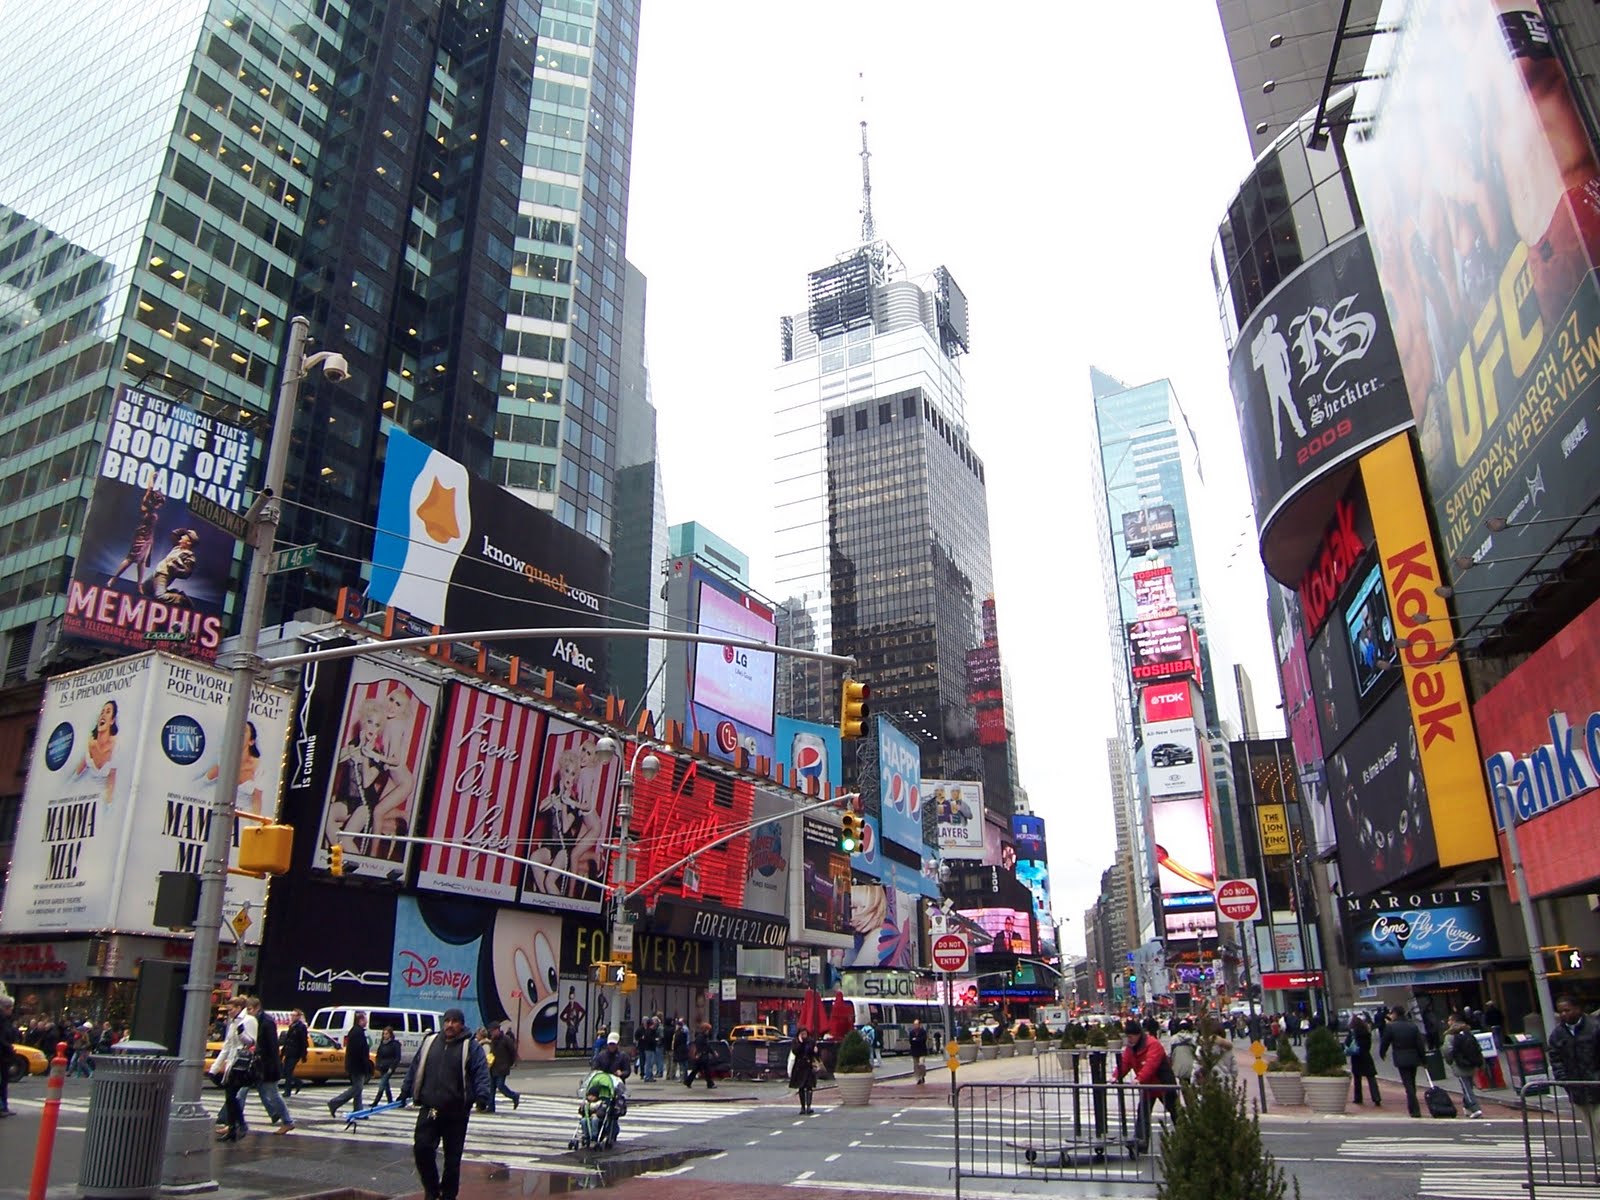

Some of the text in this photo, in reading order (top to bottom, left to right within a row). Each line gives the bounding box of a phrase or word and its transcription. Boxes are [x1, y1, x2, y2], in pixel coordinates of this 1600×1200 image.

[1446, 241, 1544, 468] UFC
[125, 388, 248, 443] THE NEW MUSICAL THAT'S
[1310, 376, 1379, 428] Sheckler
[1445, 436, 1508, 523] SATURDAY,
[1506, 352, 1558, 441] MARCH
[1558, 310, 1580, 363] 27
[116, 401, 250, 465] BLOWING THE
[1296, 418, 1353, 466] 2009
[1445, 510, 1472, 558] LIVE
[1472, 482, 1492, 517] ON
[1493, 326, 1600, 488] PAY-PER-VIEW
[109, 421, 247, 488] ROOF OFF
[102, 450, 243, 513] BROADWAY!
[191, 494, 248, 536] BROADWAY
[280, 554, 290, 568] W
[291, 551, 303, 566] 46
[483, 535, 600, 612] knowquack.com
[1134, 566, 1172, 580] TOSHIBA
[1299, 499, 1366, 640] Kodak
[67, 581, 221, 648] MEMPHIS
[552, 637, 593, 672] Aflac
[735, 651, 748, 668] LG
[1386, 540, 1463, 753] Kodak
[72, 668, 114, 688] FEEL-GOOD
[116, 657, 150, 676] MUSICAL
[1132, 659, 1195, 679] TOSHIBA
[60, 692, 69, 704] IS
[70, 691, 76, 702] A
[167, 678, 223, 705] POPULAR
[251, 689, 282, 708] MOST
[1157, 692, 1185, 705] TDK
[457, 711, 520, 763] From
[302, 734, 317, 788] IS COMING
[882, 732, 921, 785] HAPPY
[1485, 711, 1592, 833] Bank
[455, 760, 493, 801] Our
[41, 801, 97, 842] MAMMA
[161, 800, 240, 848] MAMA
[461, 806, 511, 862] Lips
[937, 826, 969, 840] LAYERS
[1263, 822, 1283, 836] LION
[1264, 813, 1279, 823] THE
[45, 840, 82, 881] MIA!
[1264, 836, 1286, 849] KING
[1222, 887, 1250, 897] DO NOT
[1226, 905, 1251, 914] ENTER
[1348, 890, 1481, 912] MARQUIS
[938, 941, 948, 949] DO
[1372, 911, 1481, 952] Come Fly Away
[399, 950, 472, 1000] Disney
[682, 941, 700, 976] 21
[940, 957, 960, 965] ENTER
[298, 982, 332, 992] IS COMING
[864, 976, 918, 997] swat
